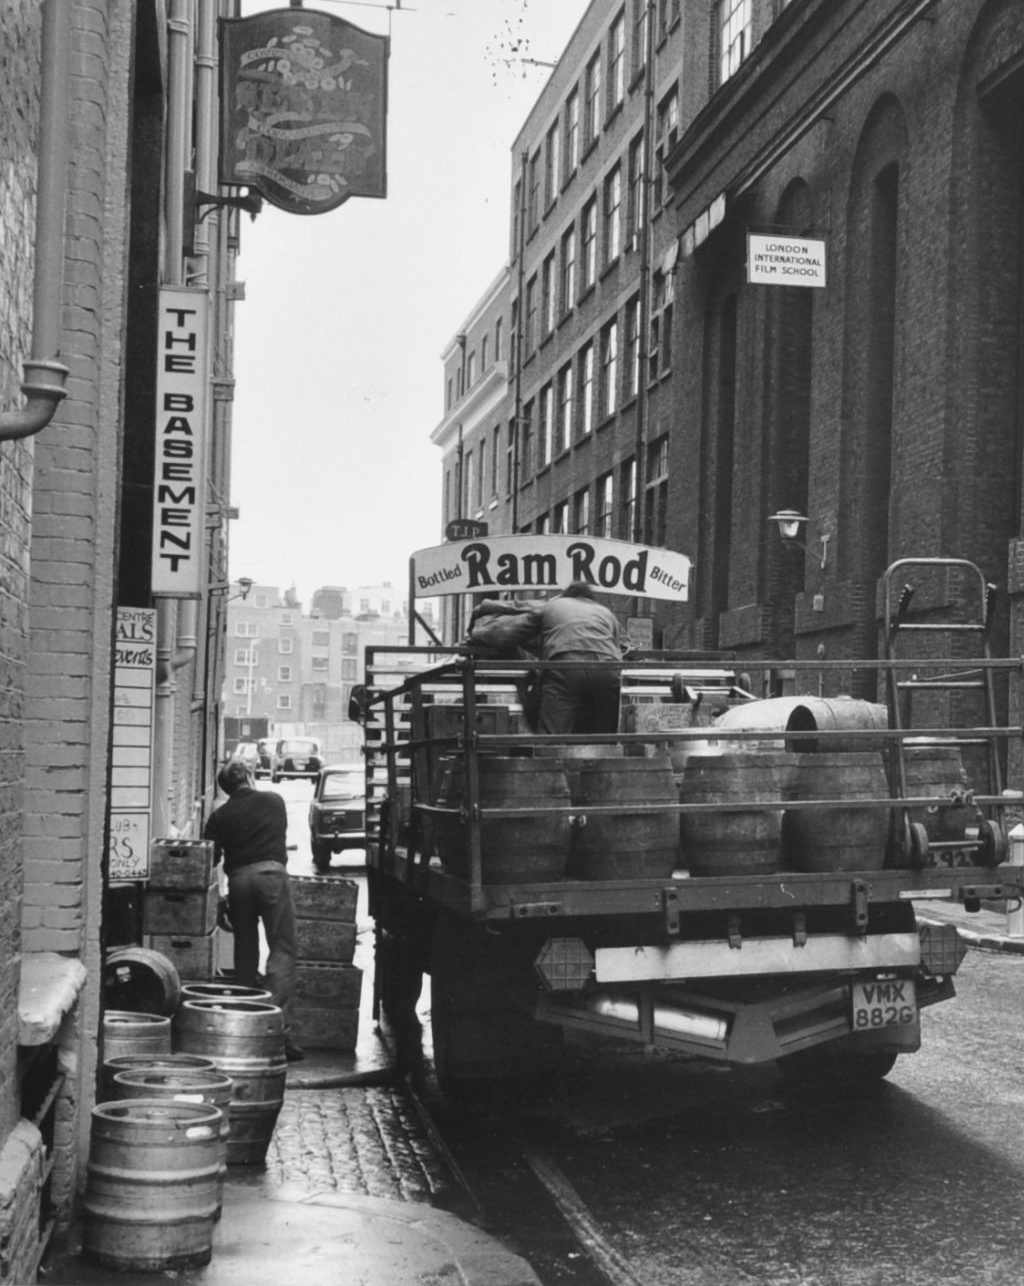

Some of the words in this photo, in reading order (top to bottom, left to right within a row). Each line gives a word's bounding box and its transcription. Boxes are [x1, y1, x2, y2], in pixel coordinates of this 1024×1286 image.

[755, 254, 821, 266] INTERNATIONAL
[765, 244, 808, 254] LONDON
[754, 265, 777, 274] FILM
[782, 266, 819, 276] SCHOOL
[164, 307, 197, 374] THE
[157, 393, 196, 573] BASEMENT
[417, 564, 463, 590] Bottled
[460, 542, 559, 589] Ram
[566, 542, 650, 593] Rod
[649, 565, 688, 594] Bitter
[862, 982, 906, 1005] VMX
[856, 1005, 914, 1028] 882G
